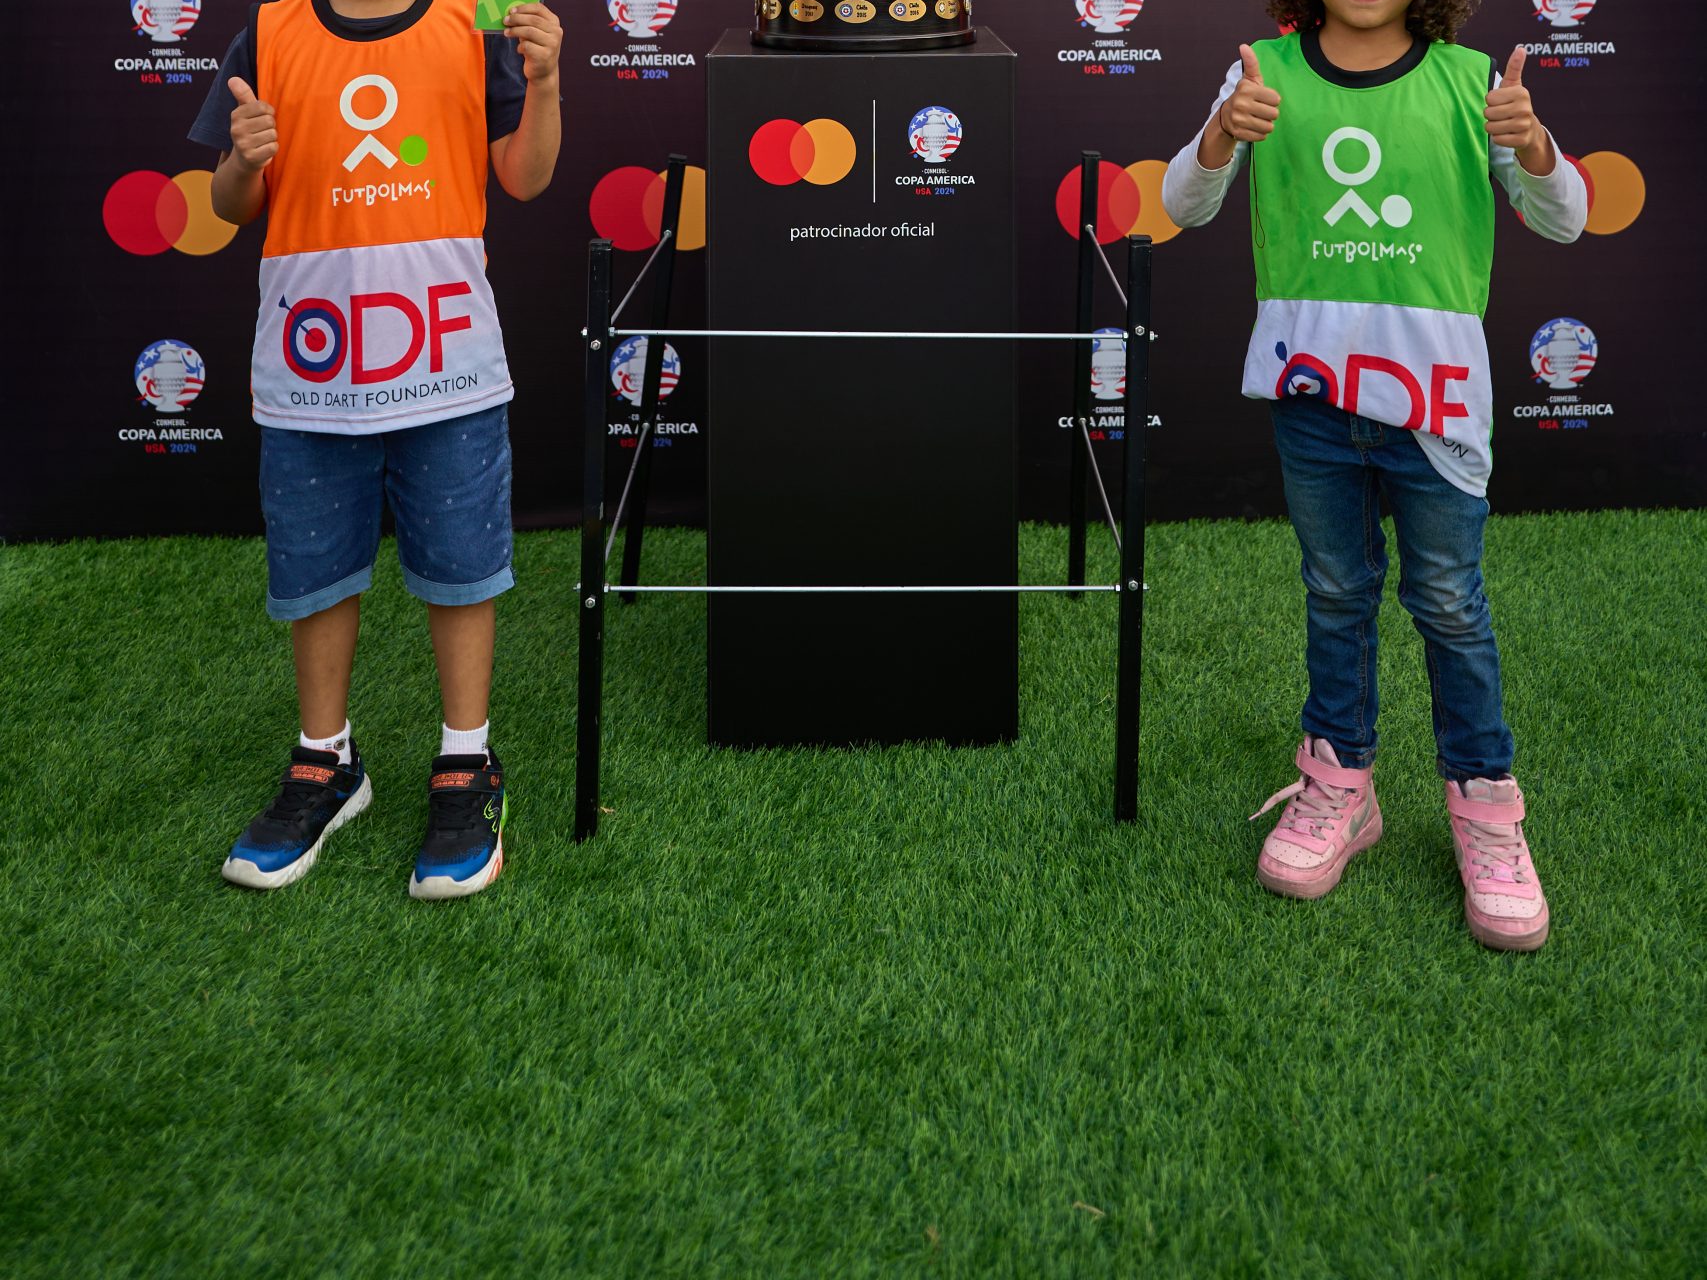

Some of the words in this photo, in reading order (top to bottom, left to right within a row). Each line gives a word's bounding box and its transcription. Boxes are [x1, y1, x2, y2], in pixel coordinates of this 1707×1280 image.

[1554, 42, 1615, 54] AMERICA
[590, 54, 629, 67] COPA
[631, 53, 696, 66] AMERICA
[1058, 49, 1096, 62] COPA
[1098, 49, 1162, 61] AMERICA
[114, 58, 152, 71] COPA
[155, 58, 219, 71] AMERICA
[1540, 57, 1560, 67] USA
[1564, 57, 1590, 67] 2024
[617, 68, 638, 79] USA
[642, 68, 669, 79] 2024
[1084, 64, 1105, 74] USA
[1109, 64, 1135, 74] 2024
[141, 73, 162, 84] USA
[166, 73, 192, 84] 2024
[895, 176, 924, 185] COPA
[926, 176, 975, 184] AMERICA
[915, 187, 932, 195] USA
[934, 187, 955, 195] 2024
[790, 223, 887, 241] patrocinador
[890, 222, 935, 237] oficial
[282, 281, 473, 385] ODF
[290, 391, 320, 406] OLD
[325, 392, 359, 408] DART
[365, 372, 479, 407] FOUNDATION
[1513, 405, 1550, 418] COPA
[1552, 404, 1614, 417] AMERICA
[634, 422, 699, 434] ERICA
[1538, 419, 1559, 429] USA
[1563, 419, 1588, 429] 2024
[118, 428, 157, 441] COPA
[159, 428, 223, 441] AMERICA
[145, 443, 166, 454] USA
[170, 443, 196, 454] 2024
